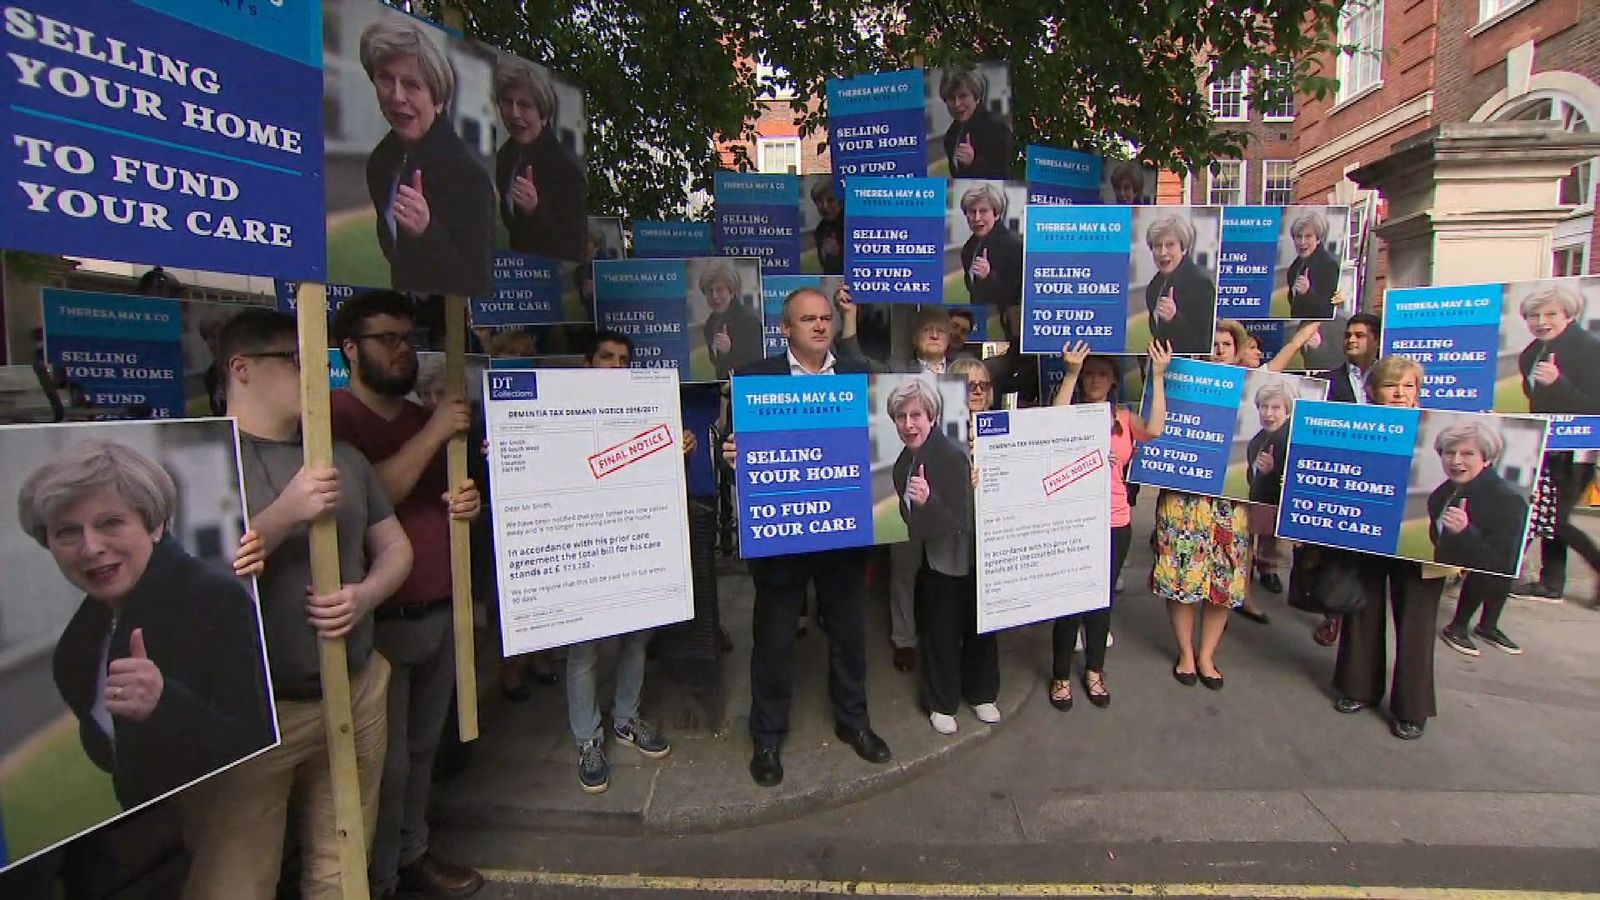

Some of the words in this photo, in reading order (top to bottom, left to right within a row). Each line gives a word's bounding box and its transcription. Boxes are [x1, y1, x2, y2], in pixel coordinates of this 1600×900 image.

[4, 6, 221, 94] SELLING
[838, 87, 871, 97] THERESA
[873, 85, 889, 94] MAY
[897, 84, 908, 92] CO
[7, 52, 167, 121] YOUR
[182, 100, 302, 154] HOME
[837, 124, 889, 138] SELLING
[838, 139, 874, 151] YOUR
[879, 136, 917, 148] HOME
[14, 134, 95, 175] TO
[111, 154, 240, 202] FUND
[839, 165, 856, 175] TO
[860, 162, 896, 173] FUND
[854, 189, 893, 198] THERESA
[895, 190, 914, 198] MAY
[923, 190, 935, 198] CO
[18, 180, 172, 231] YOUR
[186, 210, 293, 249] CARE
[722, 215, 769, 224] SELLING
[723, 227, 755, 236] YOUR
[758, 227, 793, 236] HOME
[1036, 222, 1078, 232] THERESA
[1079, 222, 1098, 232] MAY
[1108, 223, 1121, 232] CO
[853, 229, 908, 240] SELLING
[723, 246, 739, 255] TO
[742, 247, 774, 256] FUND
[853, 244, 891, 254] YOUR
[895, 244, 936, 254] HOME
[515, 270, 551, 279] HOME
[853, 268, 871, 278] TO
[875, 268, 912, 278] FUND
[1034, 268, 1091, 278] SELLING
[1236, 266, 1267, 274] HOME
[853, 282, 890, 292] YOUR
[894, 282, 930, 292] CARE
[1034, 283, 1073, 294] YOUR
[1077, 283, 1119, 294] HOME
[499, 290, 533, 299] FUND
[480, 302, 514, 312] YOUR
[519, 302, 551, 311] CARE
[1232, 298, 1260, 306] CARE
[1396, 301, 1439, 311] THERESA
[1440, 299, 1462, 309] MAY
[1474, 298, 1490, 307] CO
[59, 306, 116, 319] THERESA
[606, 312, 654, 322] SELLING
[1033, 310, 1051, 320] TO
[1056, 310, 1094, 320] FUND
[645, 323, 680, 333] HOME
[1033, 325, 1071, 335] YOUR
[1075, 326, 1113, 335] CARE
[1392, 340, 1454, 349] SELLING
[62, 351, 137, 364] SELLING
[635, 348, 661, 356] UND
[1438, 352, 1487, 362] HOME
[65, 366, 116, 379] YOUR
[122, 368, 173, 379] HOME
[493, 377, 513, 389] DT
[1195, 376, 1213, 386] MAY
[1222, 380, 1233, 389] CO
[1423, 375, 1456, 384] UND
[96, 393, 146, 404] FUND
[493, 390, 533, 398] Collections
[746, 394, 800, 405] THERESA
[802, 393, 826, 403] MAY
[828, 393, 836, 402] &
[838, 391, 853, 401] CO
[1435, 388, 1478, 397] CARE
[509, 410, 547, 418] DEMENTIA
[759, 408, 797, 416] ESTATE
[802, 406, 841, 415] AGENTS
[979, 418, 993, 427] DT
[1165, 412, 1200, 426] LLING
[1304, 417, 1351, 429] THERESA
[1352, 421, 1377, 432] MAY
[1377, 423, 1386, 433] &
[1388, 424, 1404, 434] CO
[1556, 426, 1592, 435] CARE
[1186, 428, 1225, 444] HOME
[599, 450, 628, 469] FINAL
[629, 433, 664, 455] NOTICE
[747, 448, 823, 465] SELLING
[1143, 446, 1160, 457] TO
[1163, 450, 1198, 462] FUND
[1071, 458, 1097, 475] NOTICE
[1141, 460, 1175, 473] YOUR
[1179, 465, 1213, 479] CARE
[1297, 459, 1362, 476] SELLING
[748, 468, 801, 484] YOUR
[806, 465, 860, 481] HOME
[1296, 473, 1340, 489] YOUR
[1344, 479, 1395, 496] HOME
[750, 505, 777, 519] TO
[781, 501, 831, 516] FUND
[1292, 498, 1314, 511] TO
[1317, 502, 1362, 518] FUND
[751, 523, 804, 539] YOUR
[809, 518, 856, 534] CARE
[1290, 513, 1333, 529] YOUR
[1338, 521, 1382, 536] CARE
[520, 541, 571, 556] accordance
[573, 538, 593, 549] with
[596, 537, 607, 546] his
[609, 534, 630, 545] prior
[632, 532, 650, 541] care
[509, 554, 560, 570] agreement
[562, 552, 577, 561] the
[579, 547, 599, 559] total
[601, 545, 614, 556] bill
[616, 544, 627, 553] for
[630, 542, 642, 551] his
[644, 540, 662, 549] care
[510, 568, 541, 580] stands
[543, 565, 553, 575] at
